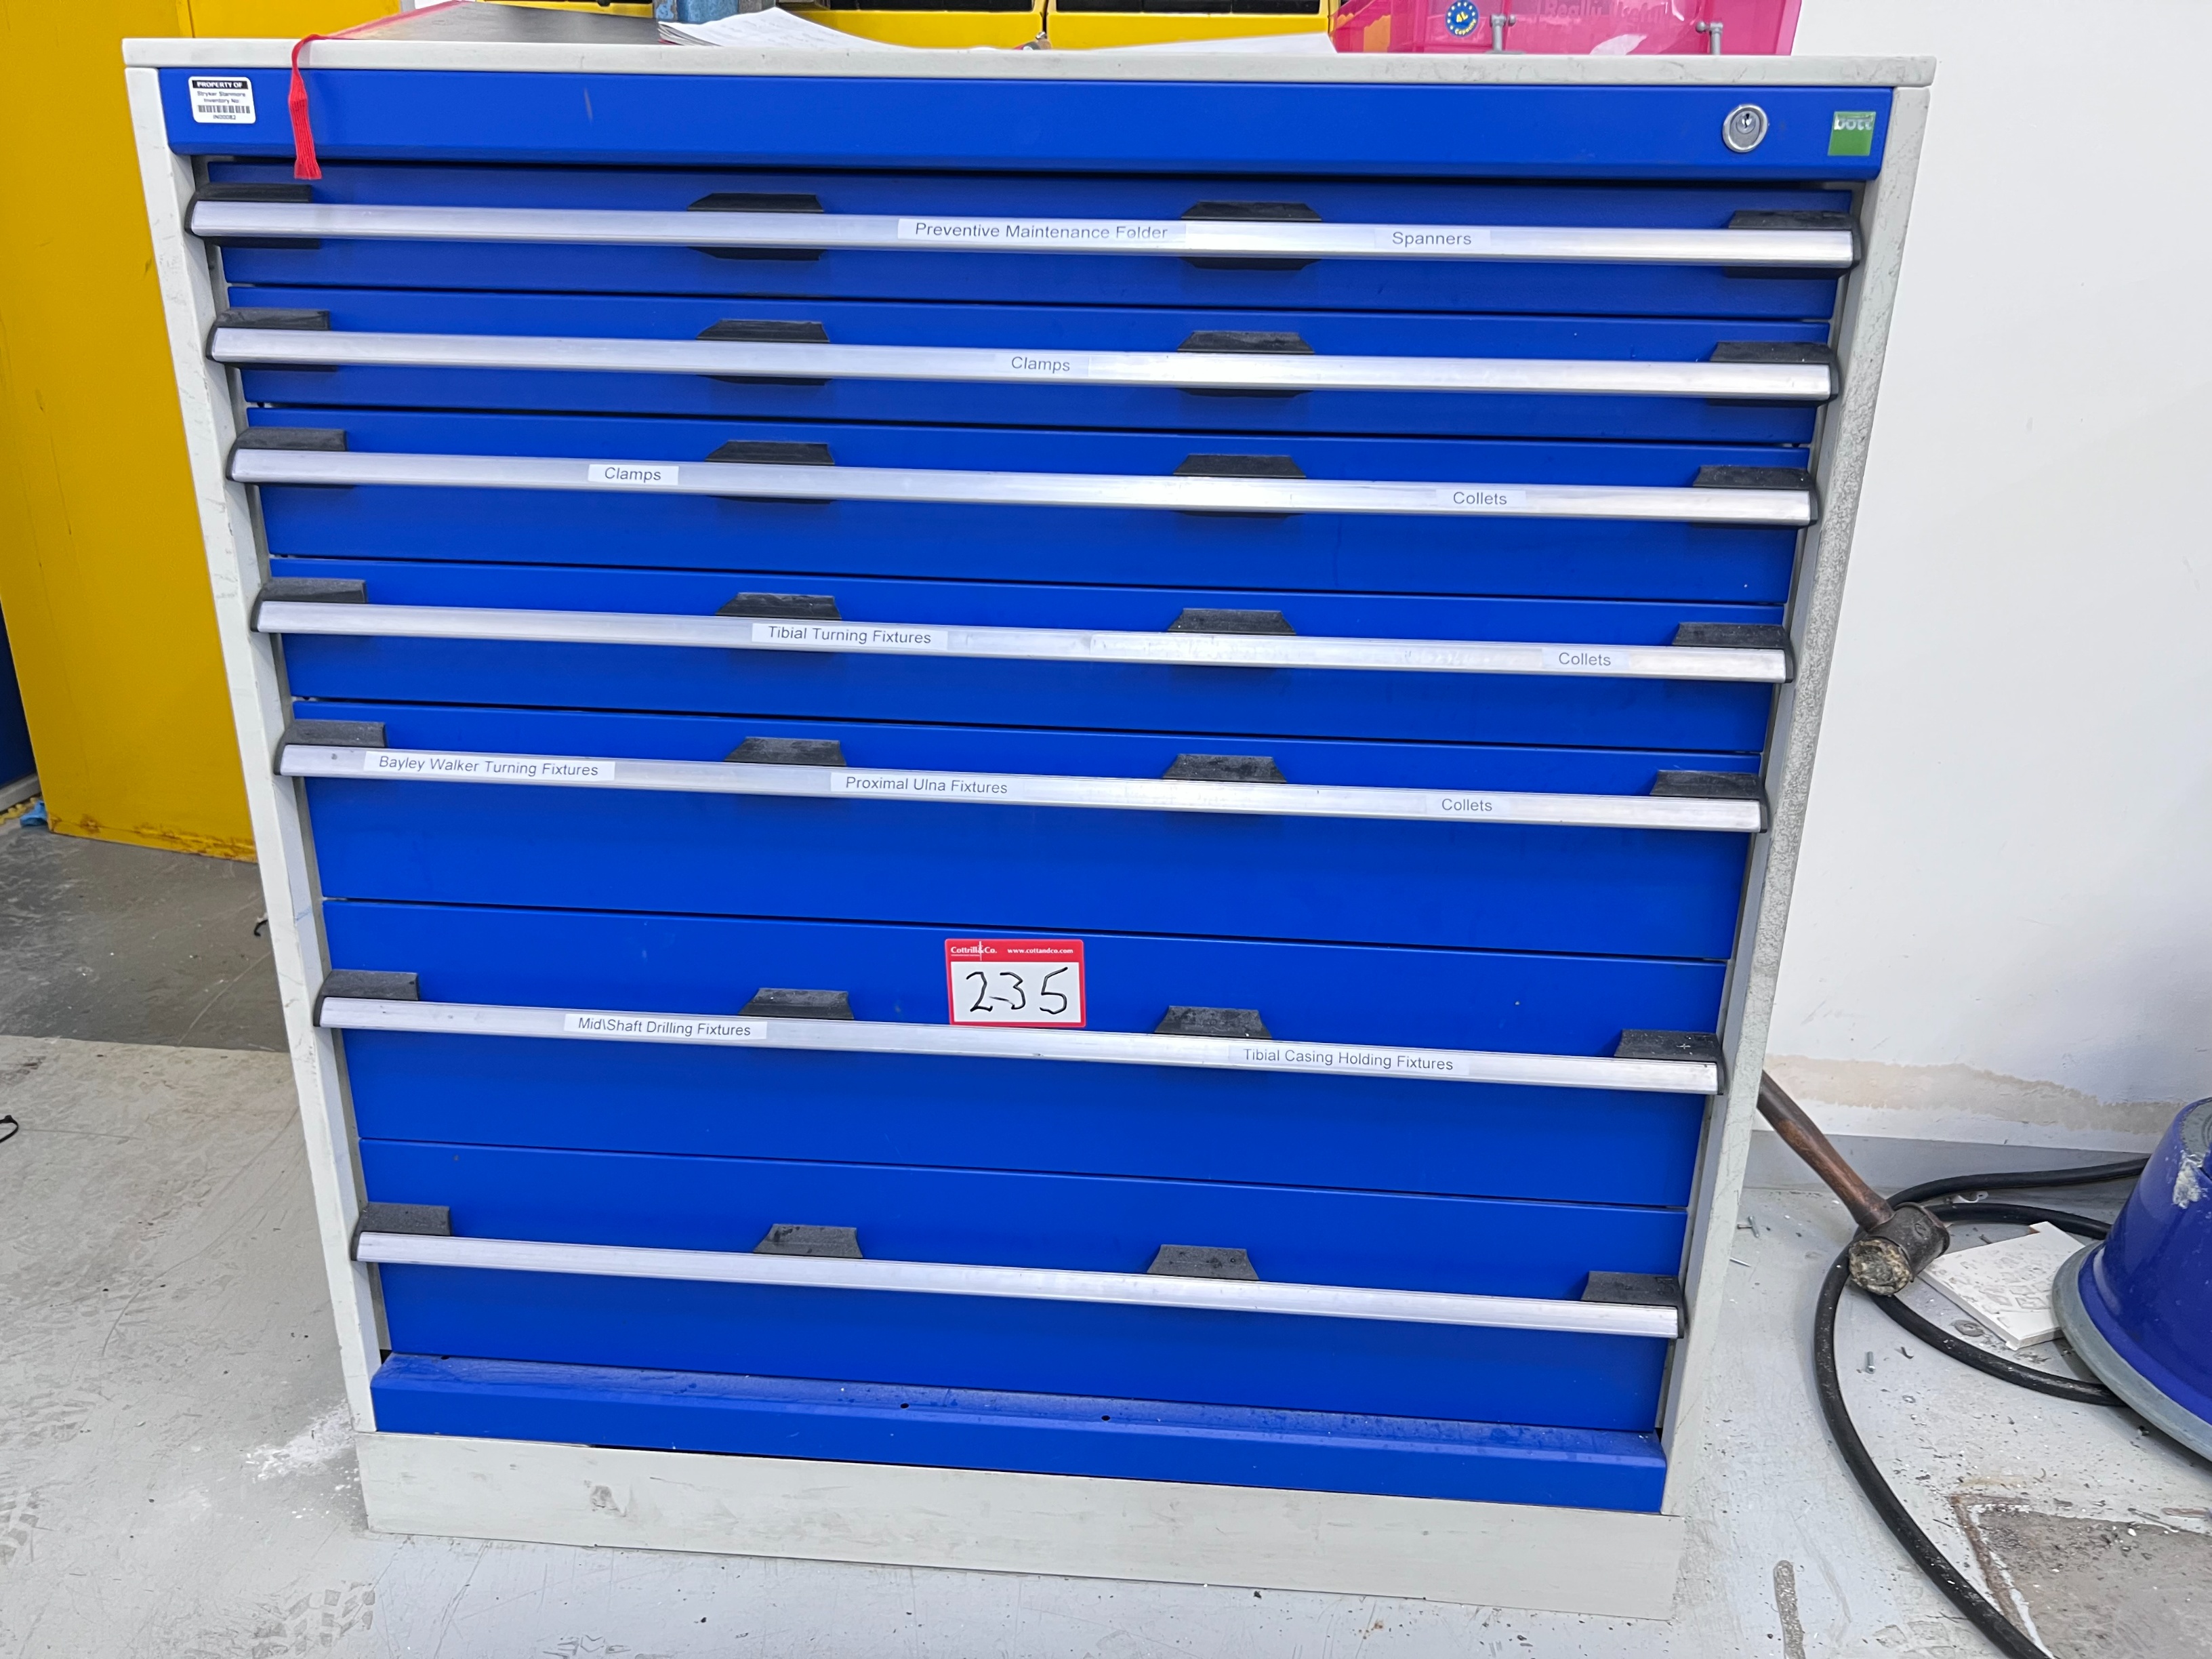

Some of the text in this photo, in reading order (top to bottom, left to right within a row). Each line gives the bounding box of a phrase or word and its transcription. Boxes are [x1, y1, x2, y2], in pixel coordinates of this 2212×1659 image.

[915, 222, 1168, 239] Preventive Maintenance Folder
[1392, 231, 1472, 248] Spanners
[1011, 356, 1071, 374] Clamps
[605, 467, 661, 483] Clamps
[1453, 491, 1507, 505] Collets
[768, 626, 931, 644] Tibial Turning Fixtures
[1559, 652, 1612, 666] Collets
[379, 756, 599, 777] Bayley Walker Turning Fixtures
[846, 776, 1008, 794] Proximal Ulna Fixtures
[1441, 798, 1492, 812] Collets
[578, 1017, 752, 1037] Mid\Shaft Drilling Fixtures
[1243, 1048, 1454, 1071] Tibial Casing Holding Fixtures
